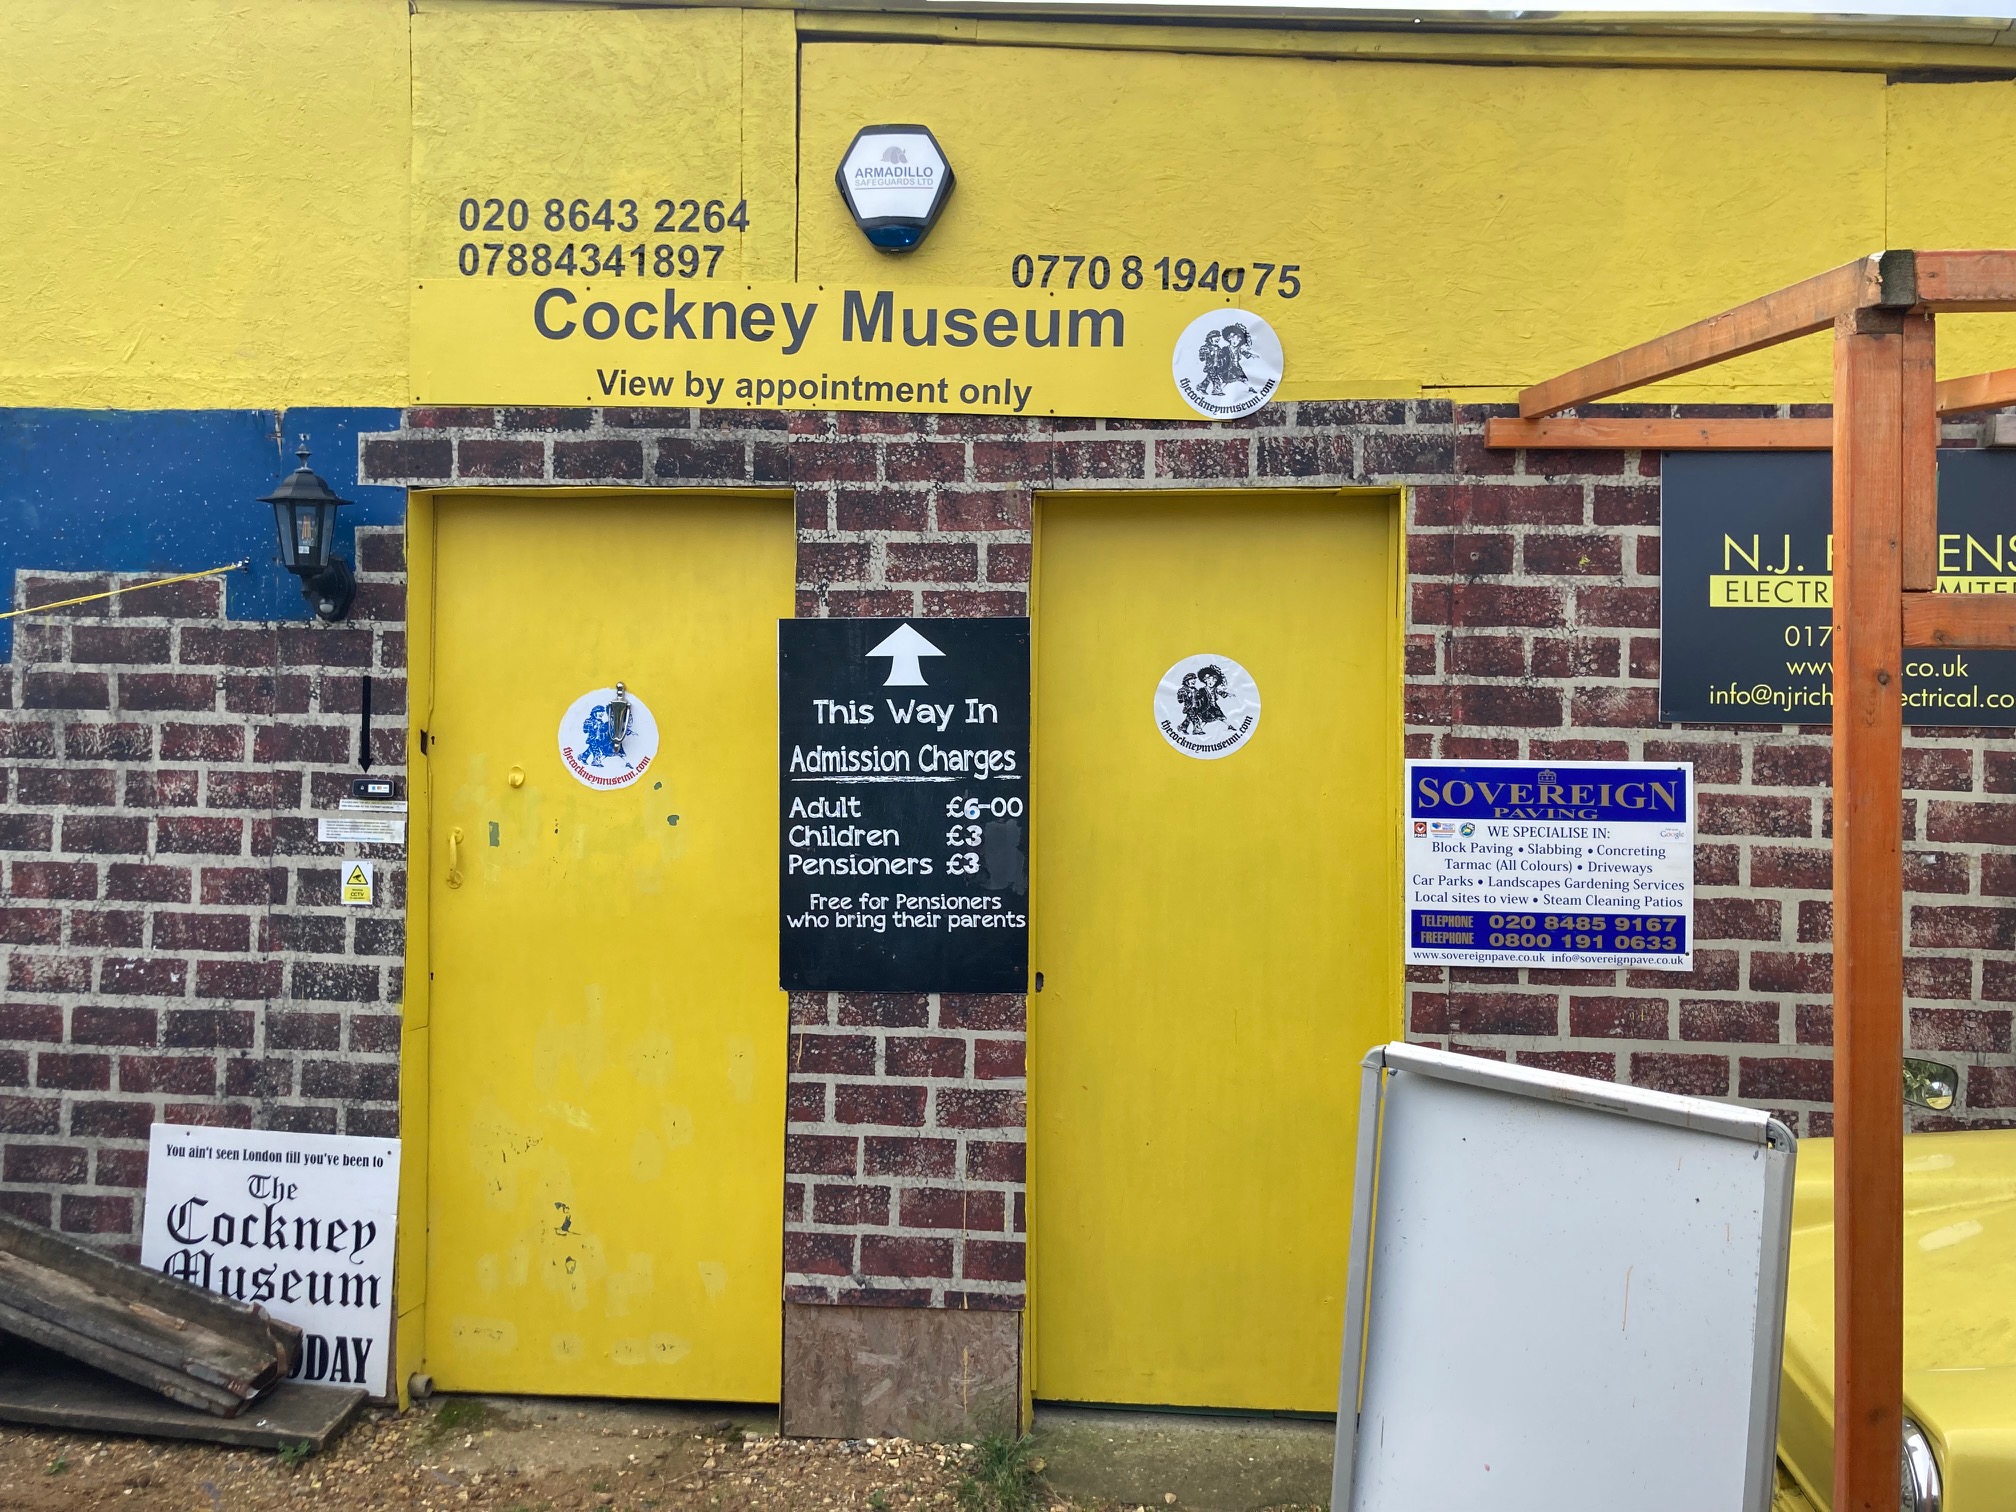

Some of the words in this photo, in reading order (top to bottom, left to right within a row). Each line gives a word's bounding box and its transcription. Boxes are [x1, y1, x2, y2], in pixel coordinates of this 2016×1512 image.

[855, 166, 933, 178] ARMADILLO
[855, 178, 915, 186] SAFEGUARDS
[917, 178, 933, 186] LTD
[459, 198, 528, 231] 020
[544, 198, 639, 232] 8643
[654, 199, 750, 233] 2264
[458, 243, 725, 278] 07884341897
[534, 287, 818, 355] Cockney
[842, 290, 1125, 348] Museum
[596, 368, 674, 396] View
[685, 370, 725, 405] by
[735, 372, 948, 405] appointment
[960, 378, 1033, 413] only
[1180, 378, 1276, 415] thecockneymuseum.com
[1724, 533, 1804, 575] N.J.
[1726, 580, 1828, 603] ELECTR
[813, 699, 873, 724] This
[886, 699, 954, 731] Way
[965, 698, 998, 724] In
[1161, 715, 1253, 753] thecockneymuseum.com
[563, 746, 651, 786] thecockneymuseum.com
[789, 744, 909, 773] Admission
[918, 744, 1016, 780] Charges
[1418, 777, 1677, 812] SOVEREIGN
[788, 796, 861, 819] Adult
[1494, 807, 1598, 820] PAVING
[788, 825, 900, 847] Children
[946, 825, 982, 847] £3
[1487, 825, 1510, 838] WE
[1513, 826, 1589, 839] SPECIALISE
[1592, 828, 1610, 839] IN:
[1660, 830, 1684, 839] Google
[1432, 842, 1466, 853] Block
[1470, 843, 1513, 857] Paving
[1528, 843, 1582, 858] Slabbing
[1597, 845, 1666, 859] Concreting
[788, 853, 933, 875] Pensioners
[946, 852, 980, 875] £3
[1445, 858, 1492, 871] Tarmac
[1496, 859, 1517, 872] (All
[1520, 860, 1573, 873] Colours)
[1588, 861, 1653, 874] Driveways
[1413, 875, 1434, 886] Car
[1438, 876, 1474, 887] Parks
[1488, 876, 1561, 891] Landscapes
[1564, 878, 1630, 893] Gardening
[1633, 879, 1685, 891] Services
[810, 893, 853, 910] Free
[859, 892, 889, 910] for
[896, 893, 1002, 910] Pensioners
[1415, 891, 1448, 903] Local
[1451, 893, 1480, 905] sites
[1484, 894, 1497, 905] to
[1500, 894, 1529, 905] view
[1543, 894, 1582, 906] Steam
[1585, 895, 1640, 909] Cleaning
[1644, 896, 1683, 908] Patios
[786, 913, 829, 928] who
[836, 912, 886, 933] bring
[892, 912, 942, 928] their
[948, 913, 1026, 932] parents
[1421, 914, 1473, 928] TELEPHONE
[1489, 915, 1536, 929] 020
[1544, 916, 1606, 931] 8485
[1615, 917, 1677, 932] 9167
[1421, 931, 1474, 945] FREEPHONE
[1489, 934, 1552, 948] 0800
[1561, 935, 1603, 949] 191
[1614, 935, 1677, 950] 0633
[1413, 951, 1545, 963] www.sovereignpave.co.uk
[1551, 953, 1683, 966] info@sovereignpave.co.uk
[166, 1144, 186, 1158] You
[188, 1145, 213, 1159] ain't
[216, 1148, 239, 1161] seen
[242, 1148, 282, 1163] London
[285, 1150, 301, 1164] till
[304, 1152, 339, 1166] you've
[342, 1153, 370, 1167] been
[373, 1155, 384, 1168] to
[247, 1174, 299, 1201] The
[167, 1195, 377, 1265] Cockney
[163, 1248, 381, 1309] Museum
